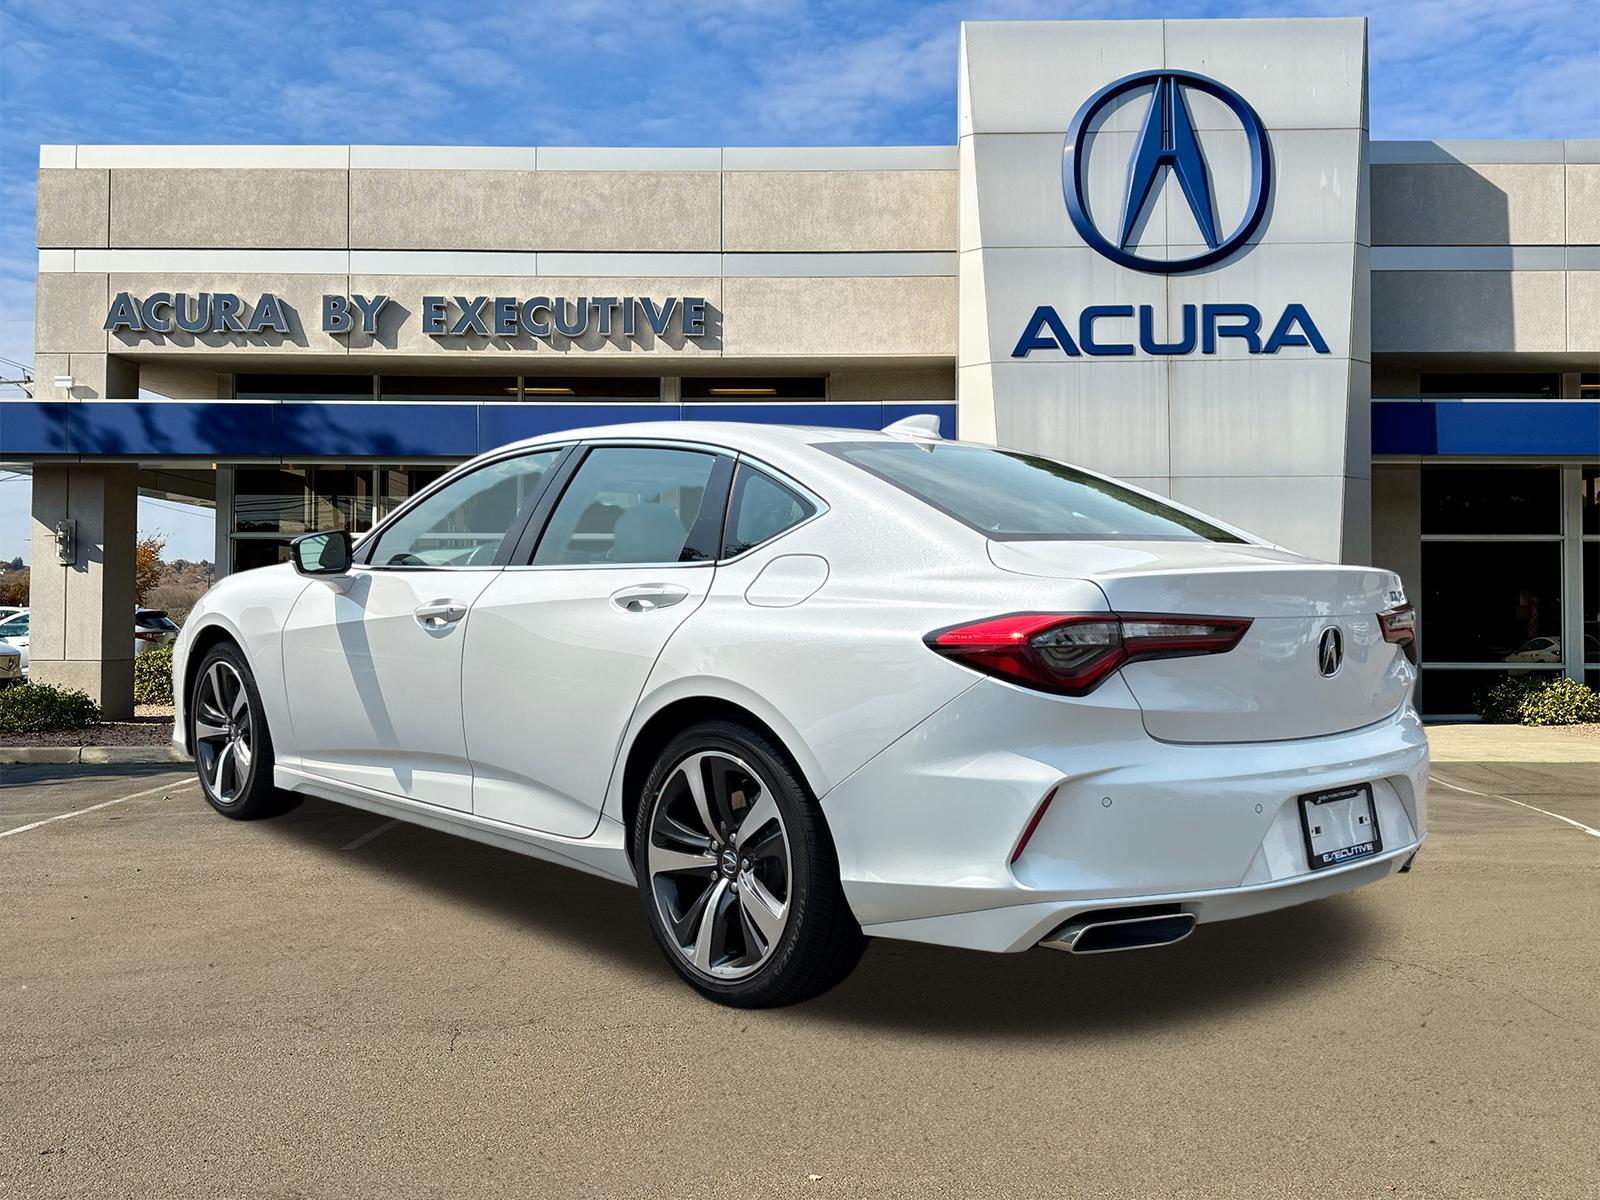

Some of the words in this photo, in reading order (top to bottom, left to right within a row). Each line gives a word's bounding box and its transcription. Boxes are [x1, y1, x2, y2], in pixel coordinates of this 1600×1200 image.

[103, 292, 289, 334] ACURA
[322, 294, 392, 335] BY
[422, 295, 708, 337] EXECUTIVE
[1011, 304, 1331, 357] ACURA
[1322, 842, 1374, 863] EXECUTIVE
